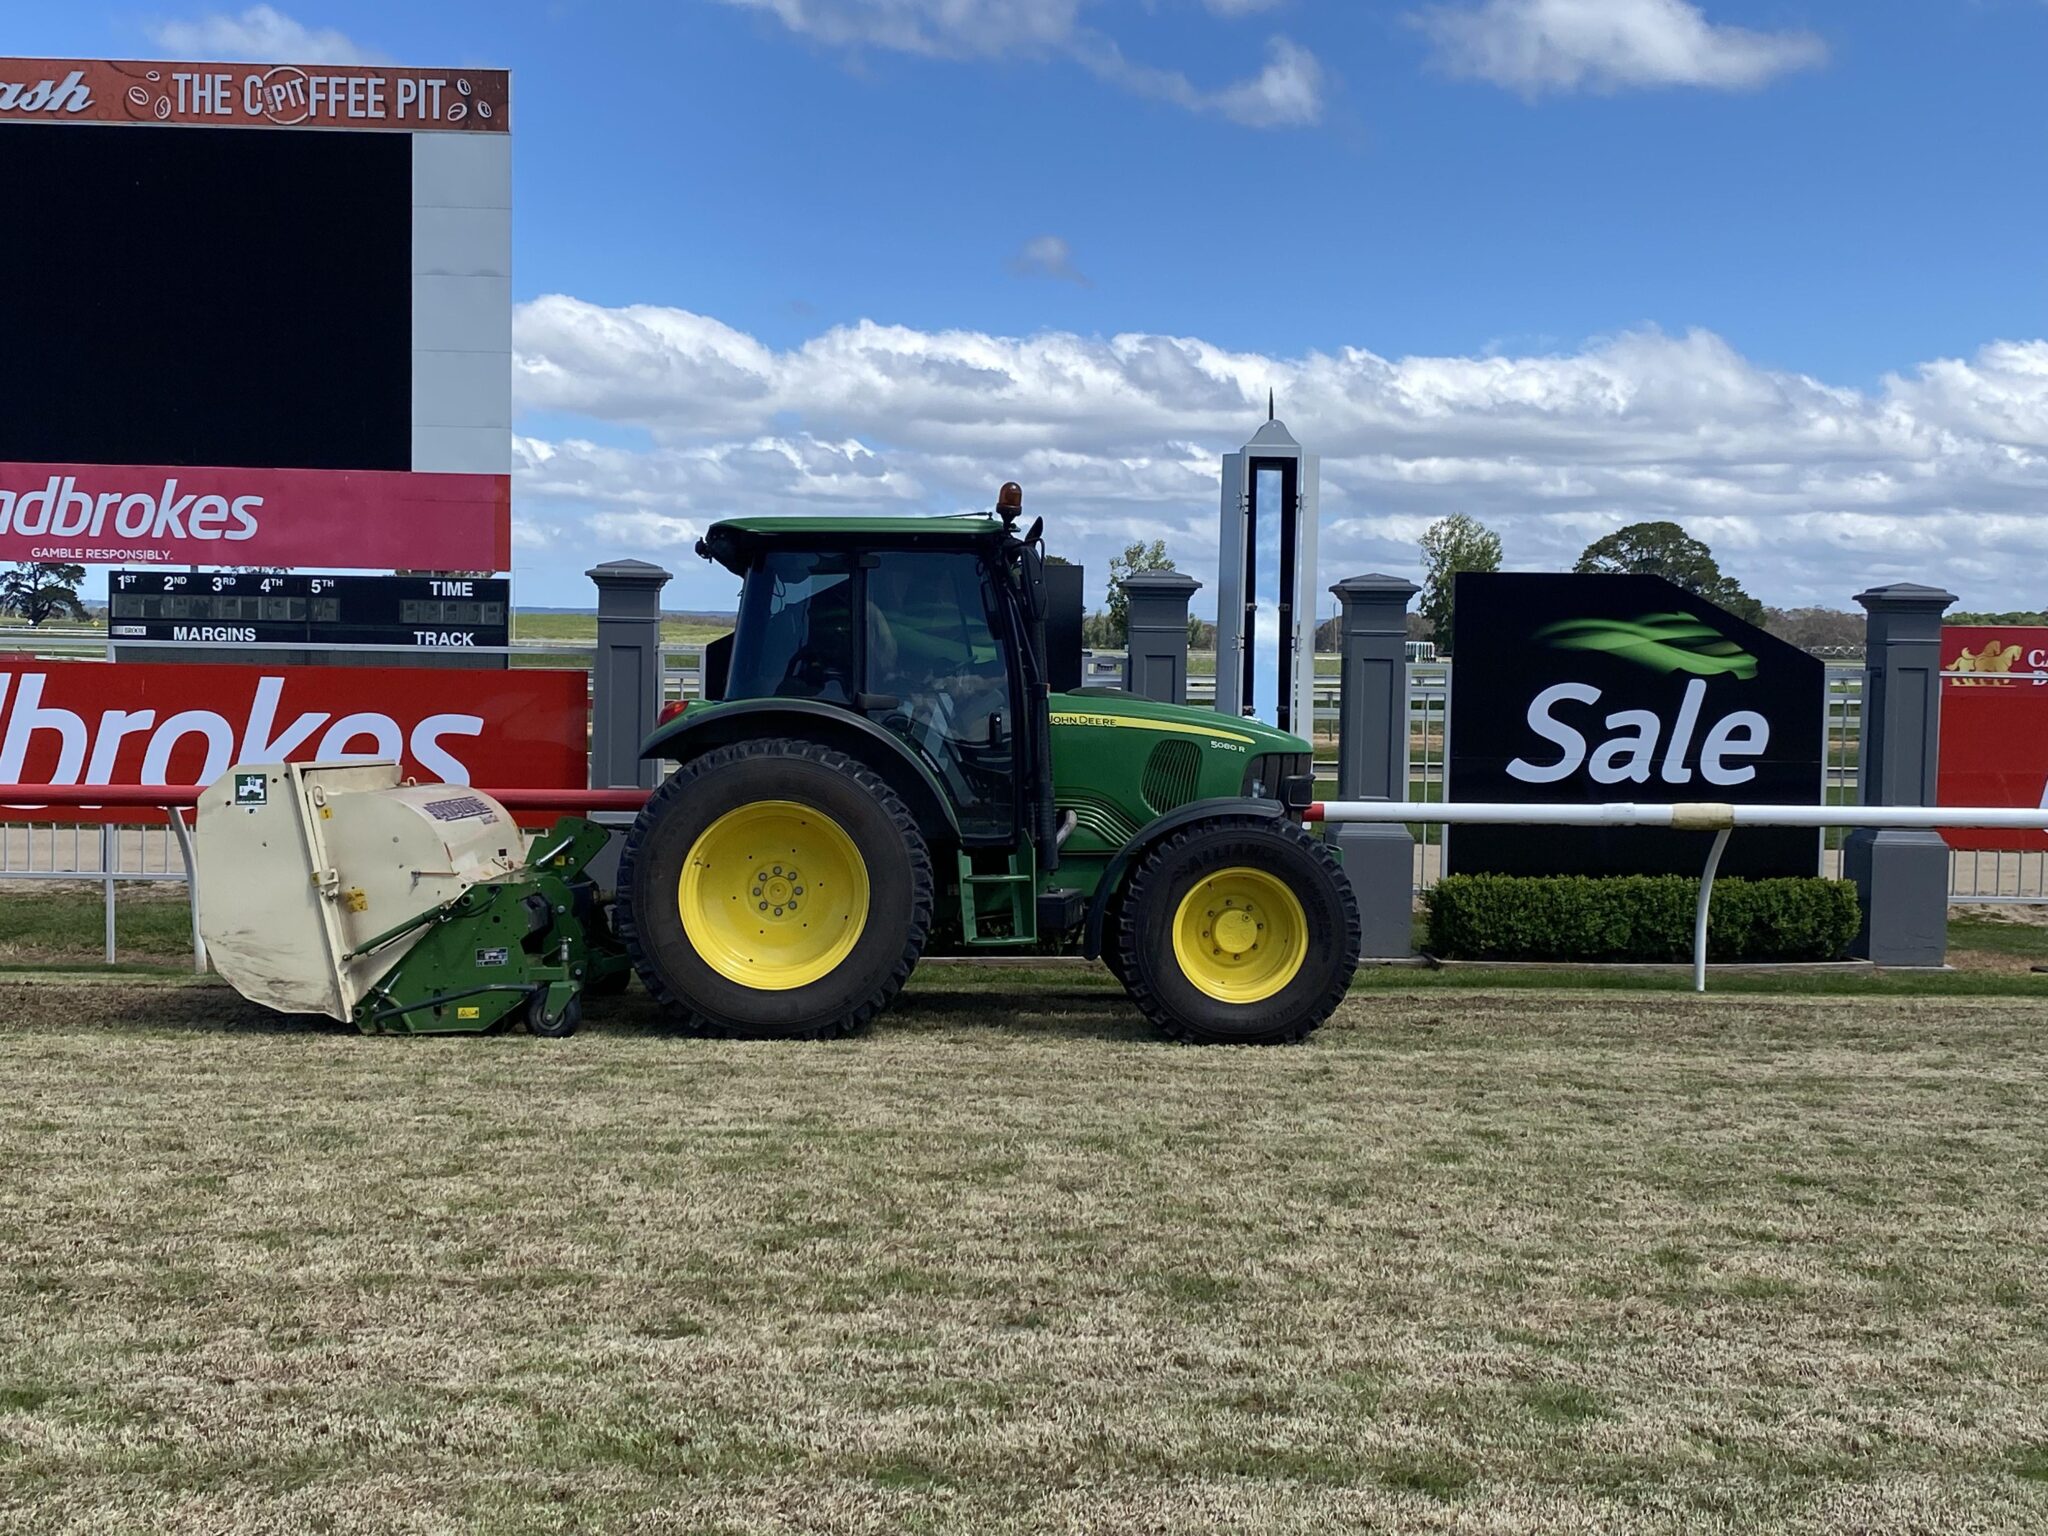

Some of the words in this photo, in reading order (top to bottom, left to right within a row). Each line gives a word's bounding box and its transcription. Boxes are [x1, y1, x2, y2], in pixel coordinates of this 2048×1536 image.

[172, 73, 233, 115] THE
[397, 78, 446, 120] PIT
[31, 547, 83, 559] GAMBLE
[86, 549, 174, 561] RESPONSIBLY.
[117, 575, 137, 590] 1ST
[163, 576, 188, 591] 2ND
[212, 577, 236, 592] 3RD
[260, 578, 284, 593] 4TH
[310, 579, 335, 594] 5TH
[429, 581, 474, 597] TIME
[173, 626, 256, 642] MARGINS
[413, 631, 475, 647] TRACK
[1049, 715, 1077, 725] JOHN
[1079, 715, 1117, 726] DEERE
[1505, 678, 1770, 785] Sale
[1238, 745, 1246, 753] R
